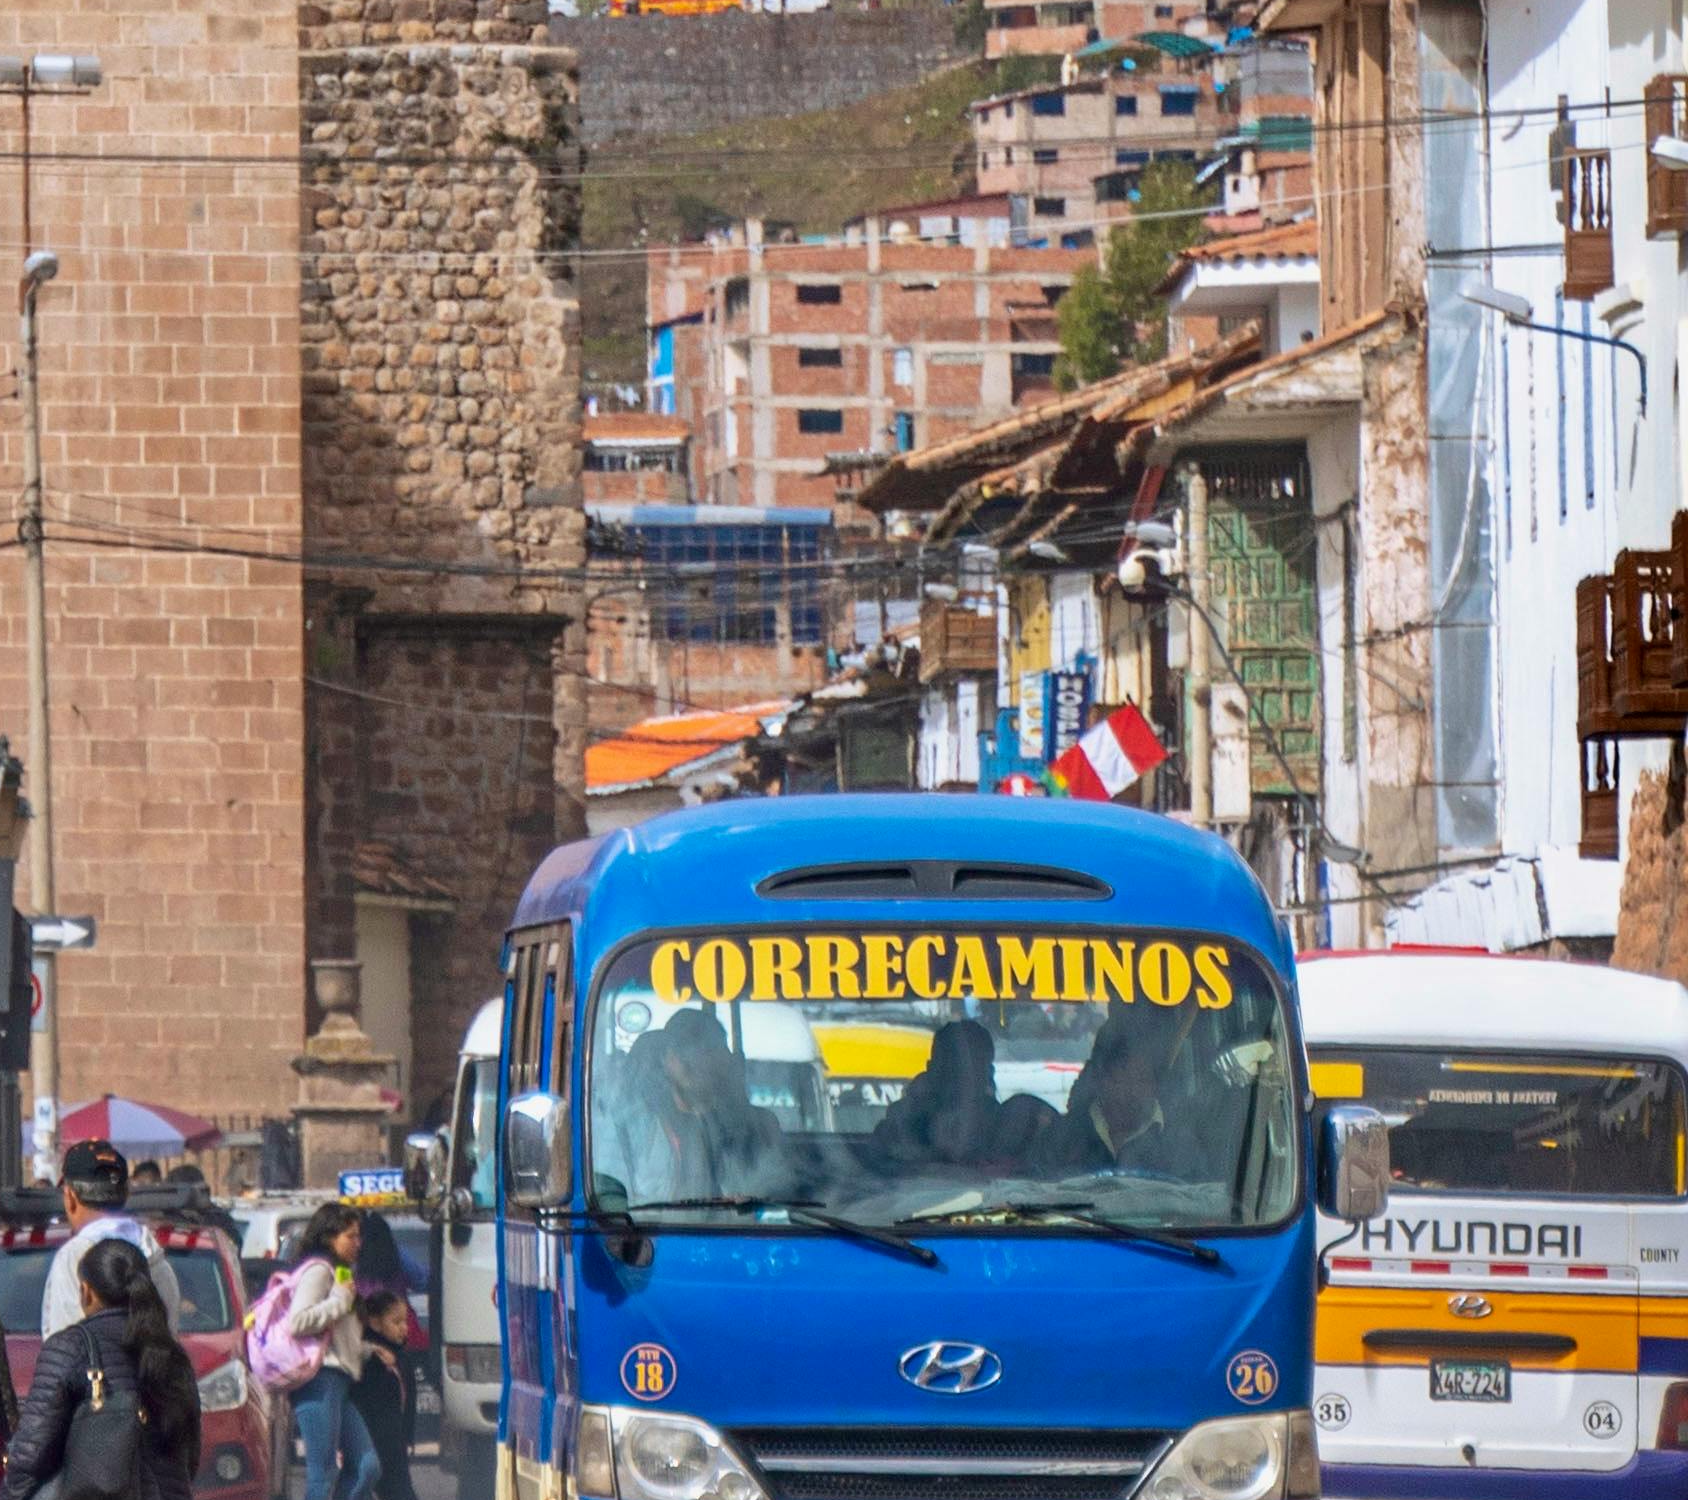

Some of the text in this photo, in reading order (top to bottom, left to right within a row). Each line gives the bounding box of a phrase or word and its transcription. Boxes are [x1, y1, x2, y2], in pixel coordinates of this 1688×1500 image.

[650, 935, 1233, 1008] CORRECAMINOS
[1363, 1219, 1582, 1258] HYUNDAI
[1640, 1248, 1679, 1264] COUNTY
[635, 1363, 663, 1392] 18
[1236, 1364, 1272, 1396] 26
[1319, 1403, 1346, 1421] 35
[1588, 1412, 1615, 1430] 04
